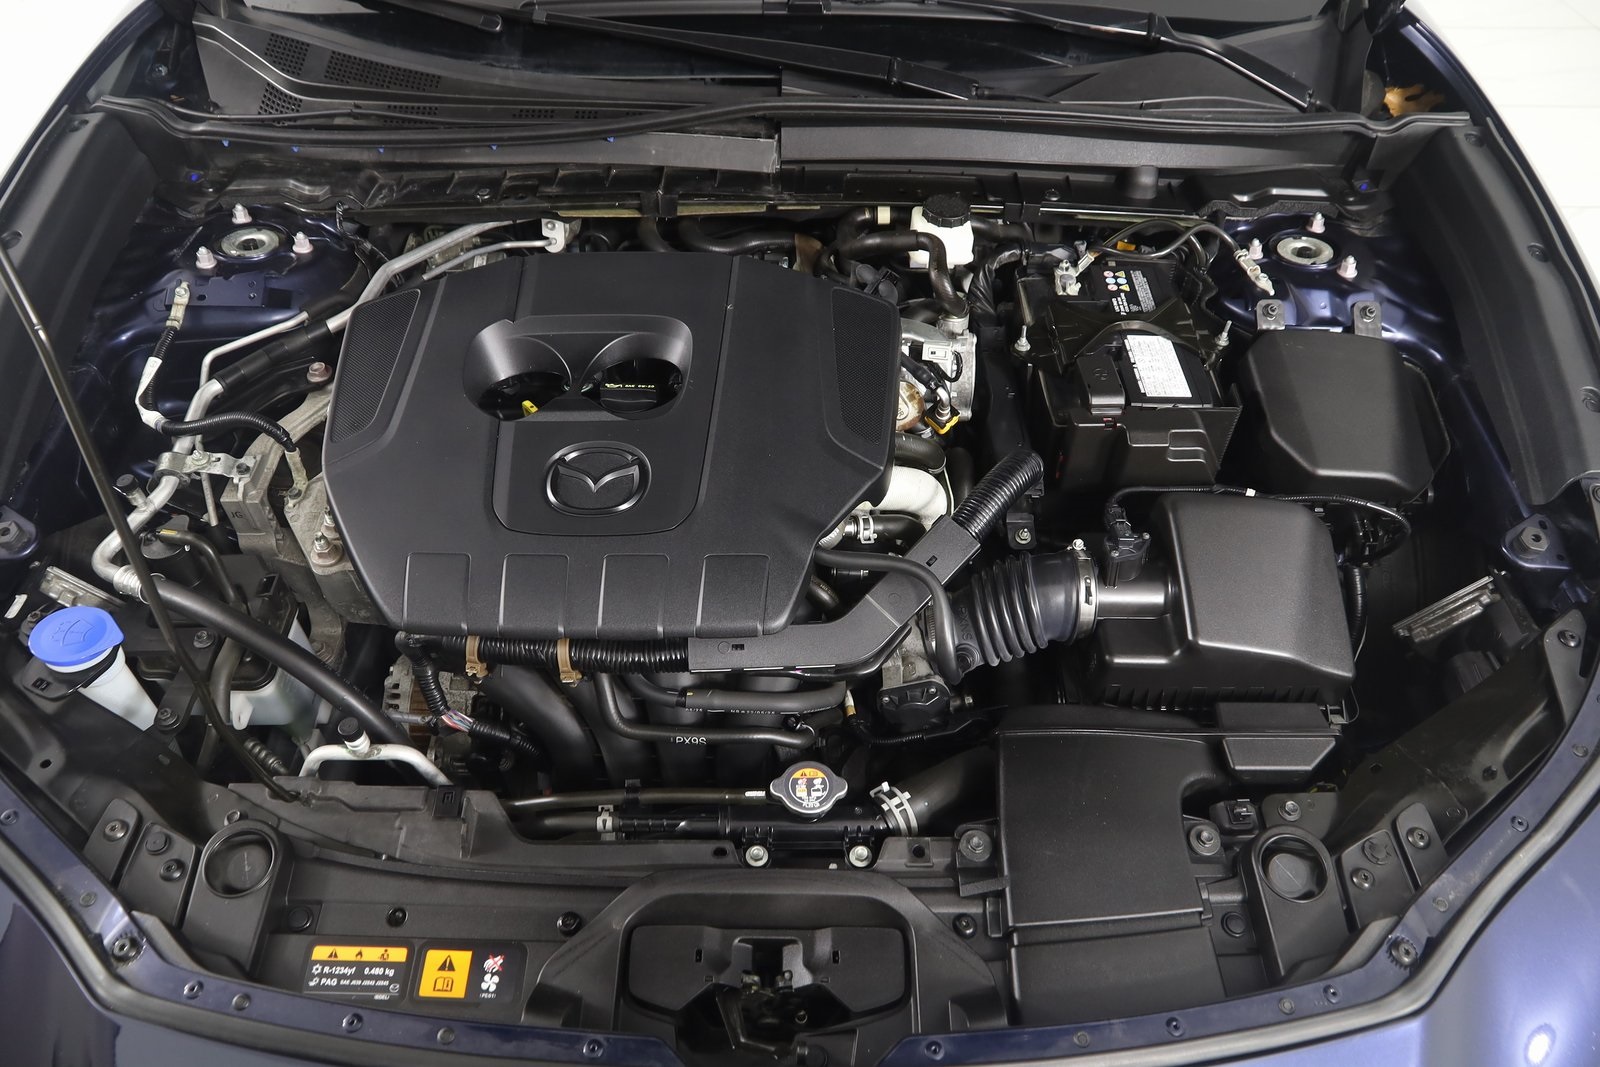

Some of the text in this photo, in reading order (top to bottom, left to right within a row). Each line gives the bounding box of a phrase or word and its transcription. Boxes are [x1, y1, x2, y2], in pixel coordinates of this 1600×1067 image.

[322, 966, 395, 977] R-1234yf 0.480 kg
[320, 978, 338, 986] PAG
